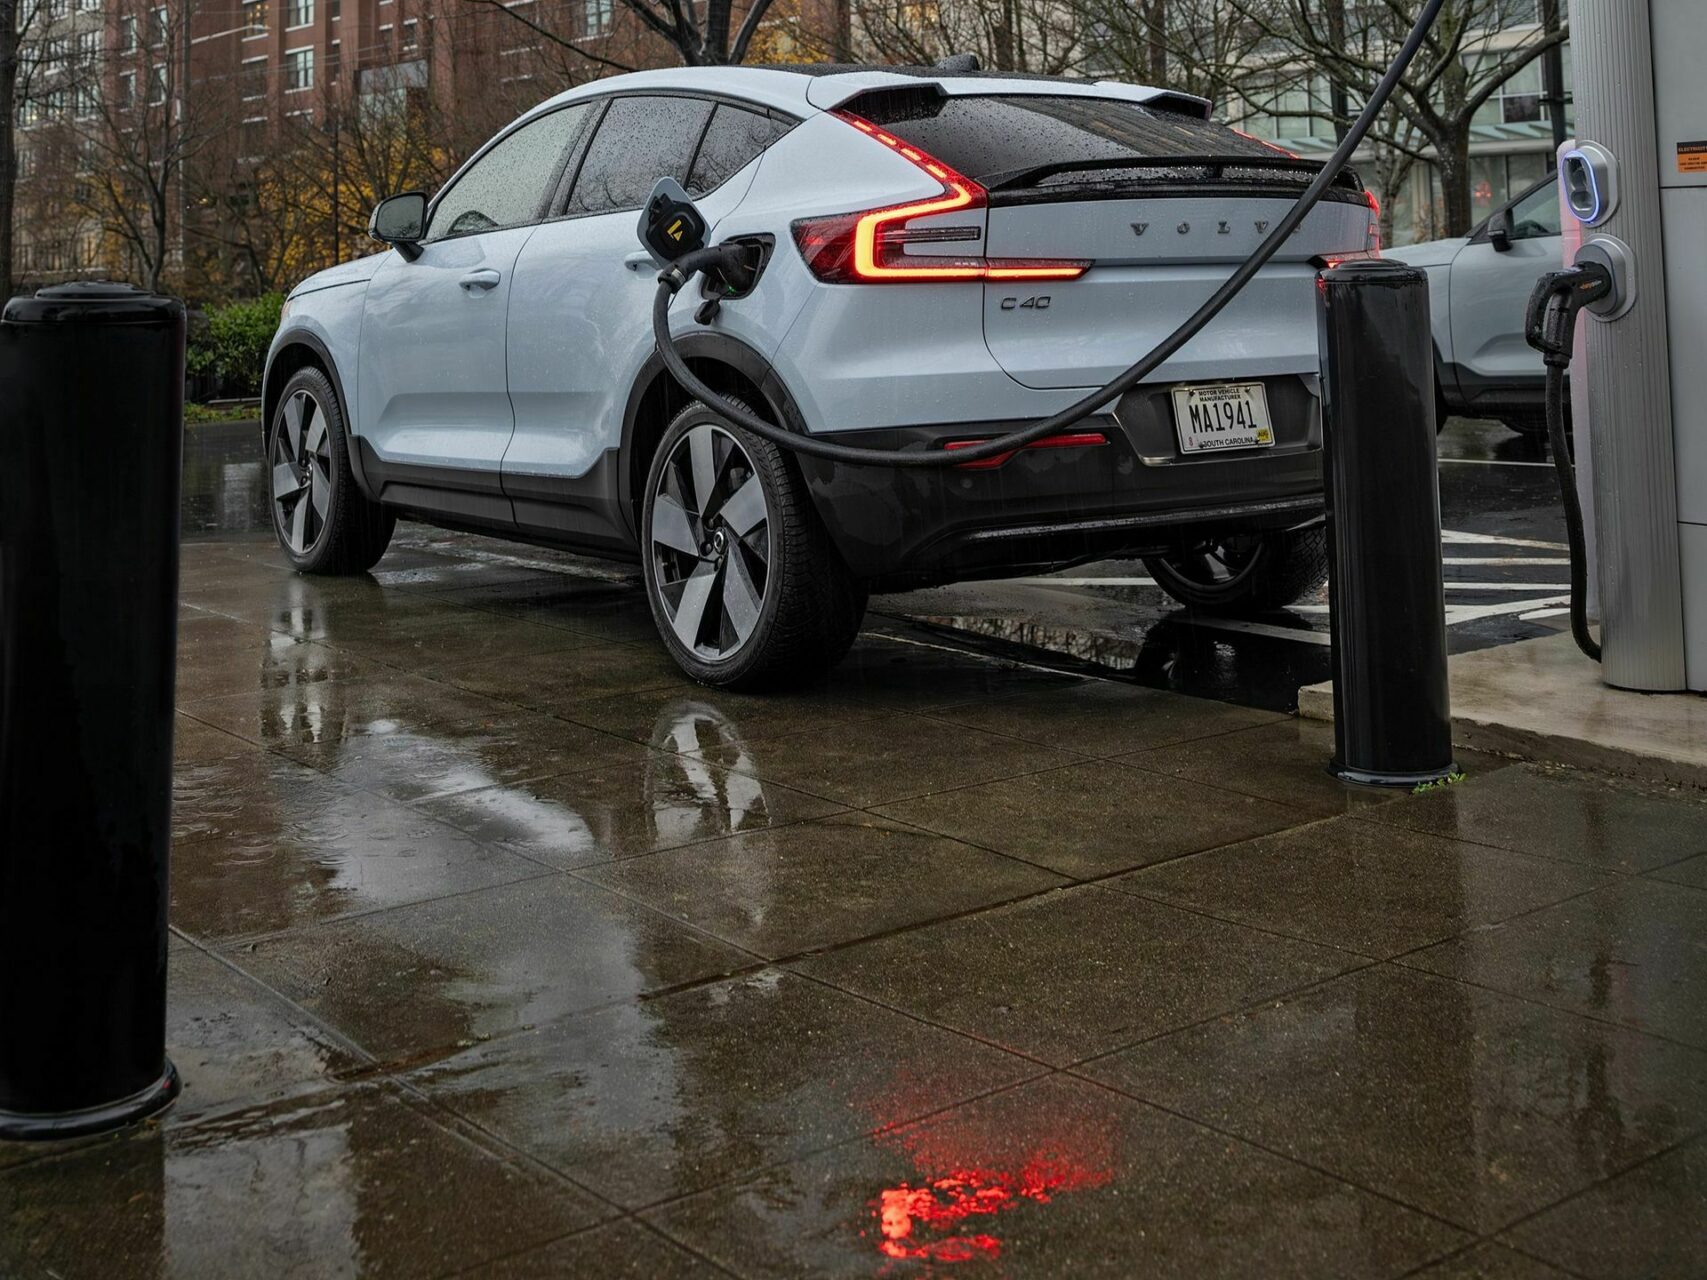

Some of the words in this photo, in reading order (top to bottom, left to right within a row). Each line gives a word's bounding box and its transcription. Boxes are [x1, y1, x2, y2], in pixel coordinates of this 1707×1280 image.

[1001, 296, 1051, 310] C40
[1218, 387, 1240, 395] VEHICLE
[1199, 394, 1241, 402] MANUFACTURER
[1188, 400, 1257, 434] MA1941
[1202, 439, 1225, 448] SOUTH
[1225, 436, 1253, 446] CAROLINA
